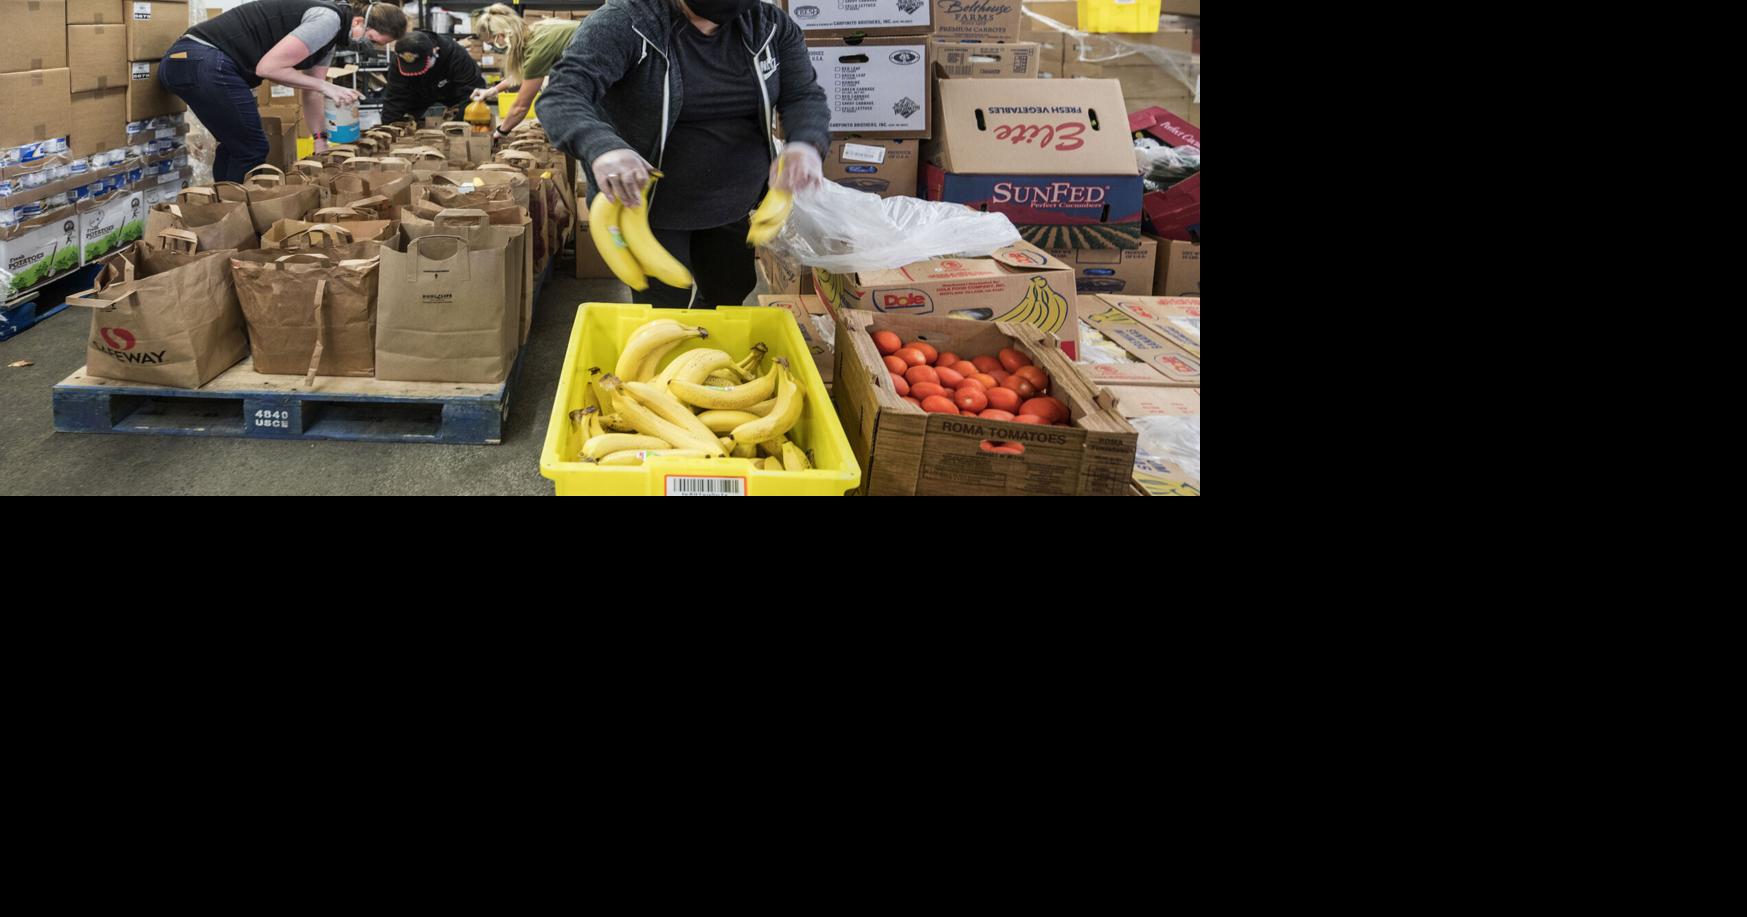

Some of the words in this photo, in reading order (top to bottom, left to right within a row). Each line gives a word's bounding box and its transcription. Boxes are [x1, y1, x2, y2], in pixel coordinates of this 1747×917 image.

[955, 13, 994, 21] FARMS
[988, 106, 1050, 114] VEGETABLES
[1050, 106, 1082, 114] FRESH
[993, 122, 1086, 151] Elite
[1030, 201, 1058, 209] Perfect
[1058, 201, 1102, 209] Cucumbers
[883, 293, 926, 306] Dole
[255, 409, 289, 420] 4840
[942, 421, 984, 436] ROMA
[989, 427, 1067, 445] TOMATOES
